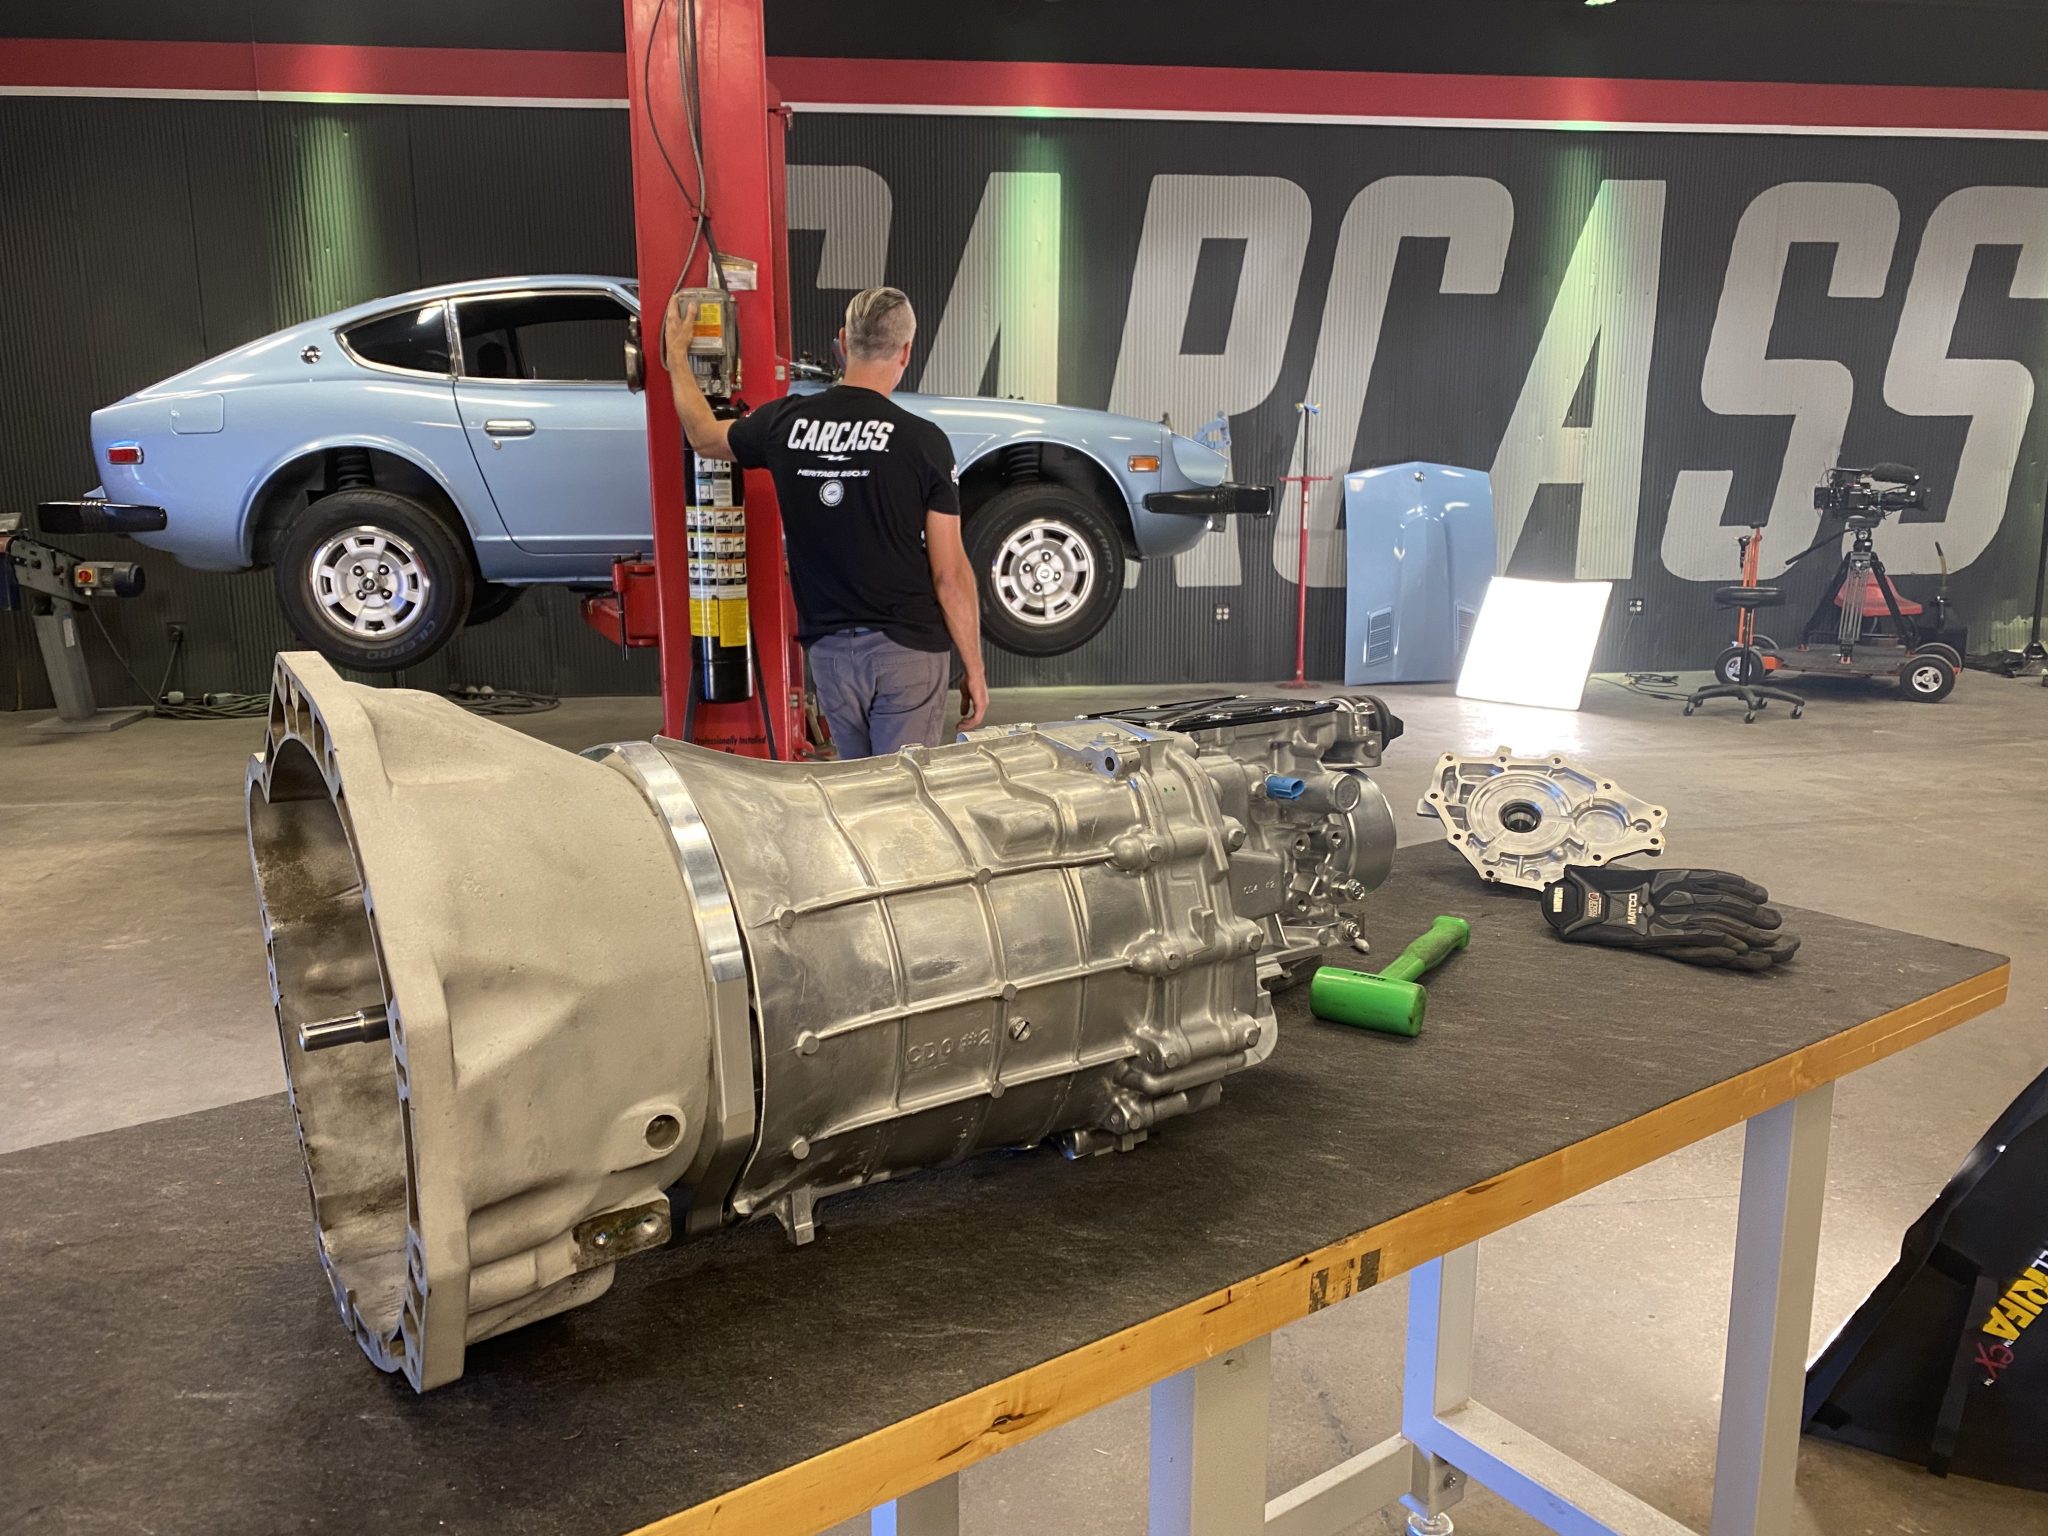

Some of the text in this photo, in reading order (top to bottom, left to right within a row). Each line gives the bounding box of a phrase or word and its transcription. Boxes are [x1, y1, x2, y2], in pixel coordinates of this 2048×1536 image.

[787, 418, 895, 453] CARCASS
[797, 468, 840, 478] HERITAGE
[1627, 893, 1638, 925] MATCO
